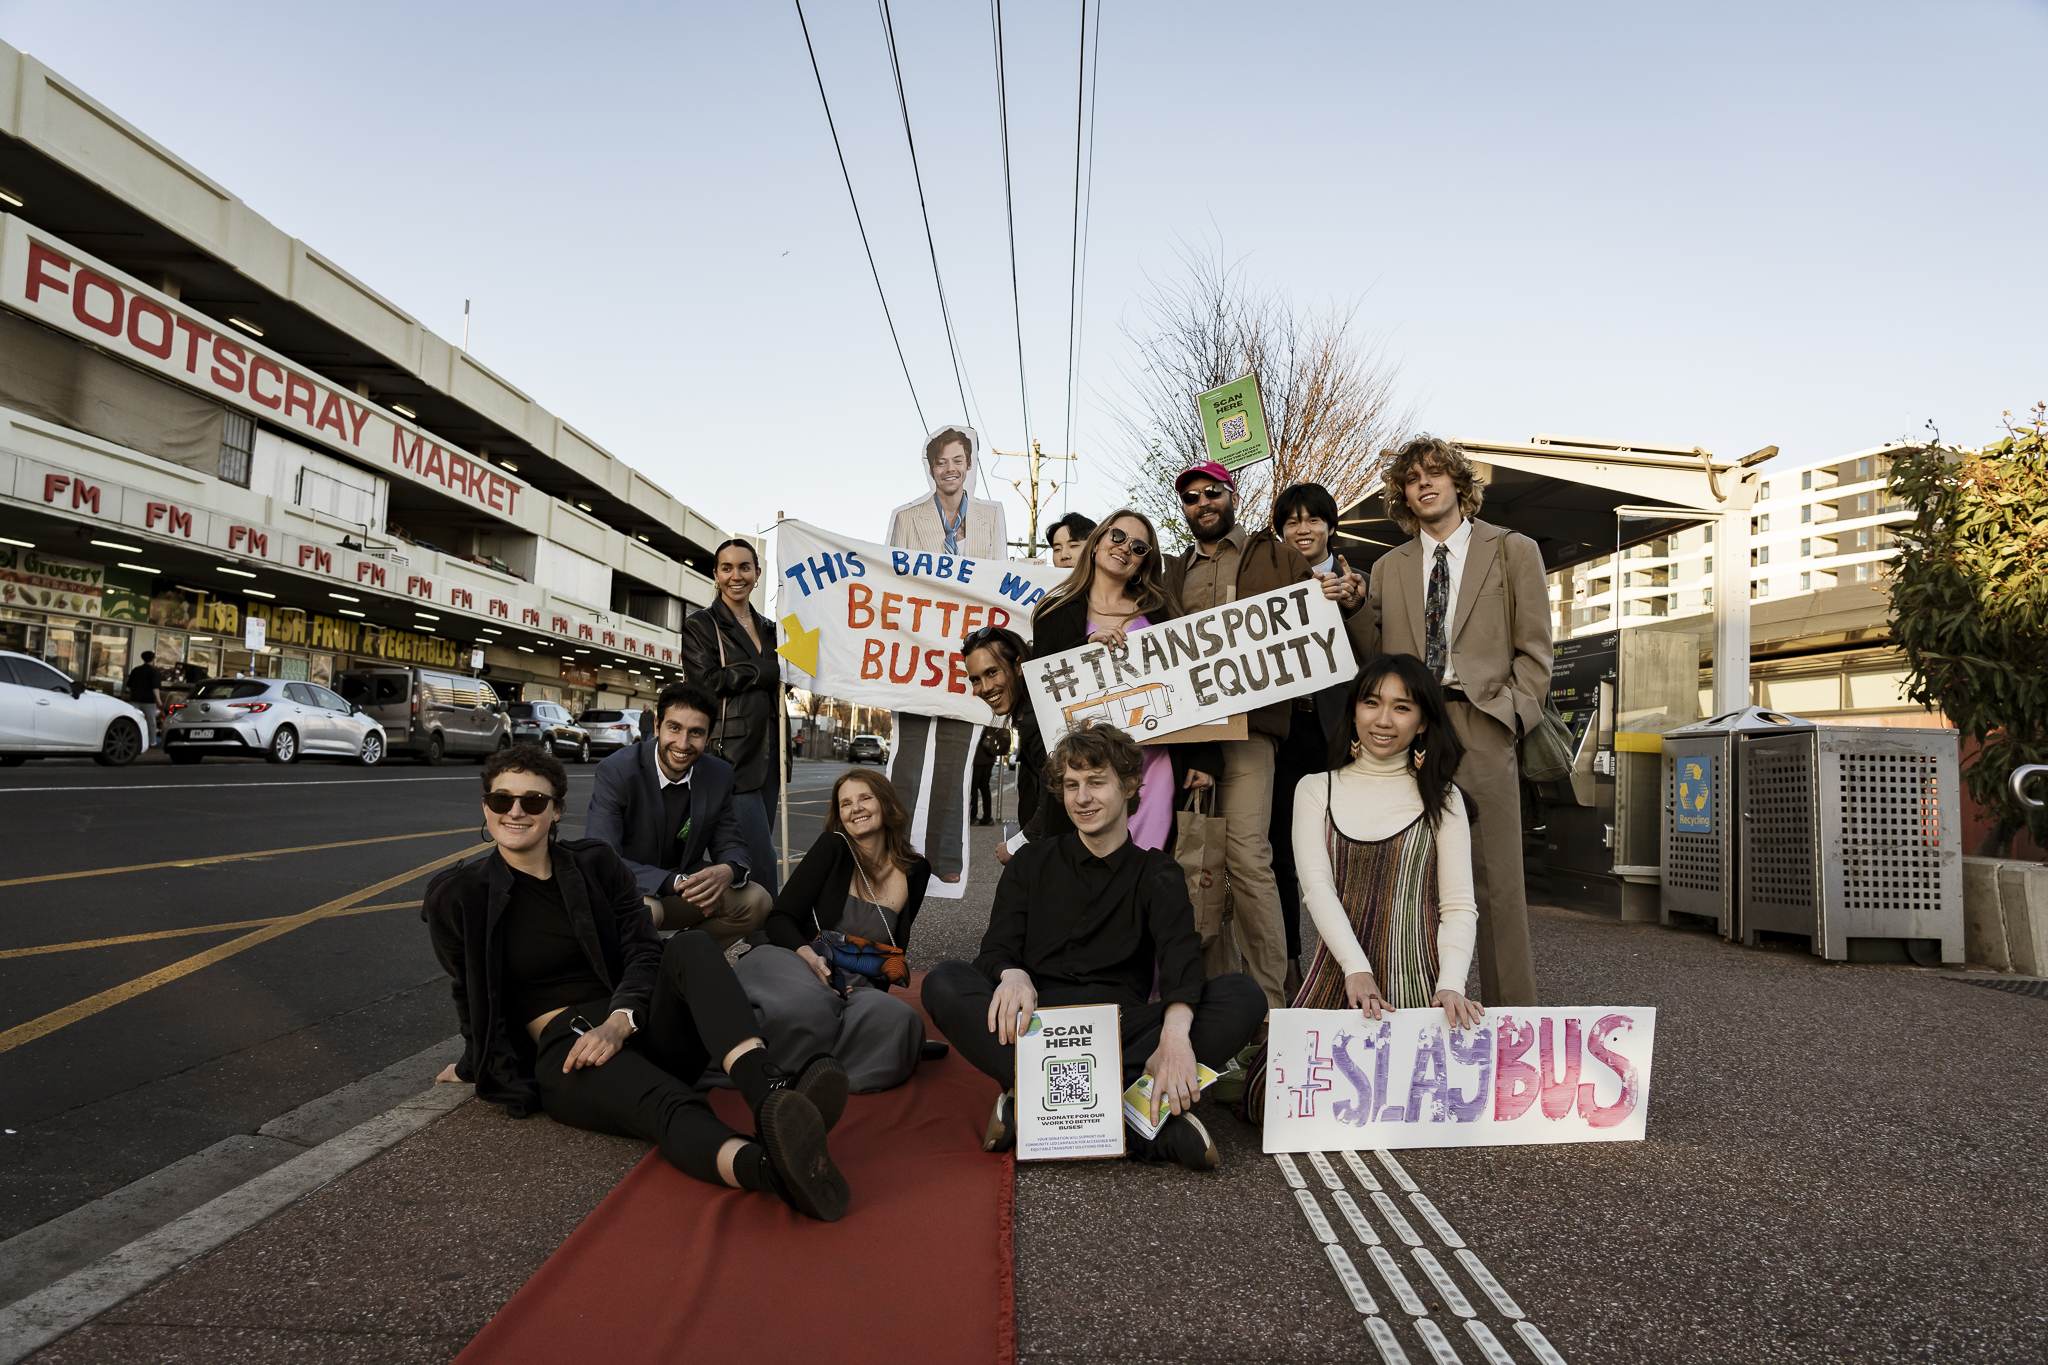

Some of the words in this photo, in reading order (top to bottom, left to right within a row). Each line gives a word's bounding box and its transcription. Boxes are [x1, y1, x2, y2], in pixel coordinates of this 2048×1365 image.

[25, 241, 371, 447] FOOTSCRAY
[392, 424, 521, 516] MARKET
[1213, 393, 1243, 409] SCAN
[1216, 400, 1243, 415] HERE
[24, 551, 102, 588] Grocery
[43, 473, 100, 513] FM
[146, 502, 192, 537] FM
[229, 525, 268, 556] FM
[298, 544, 332, 572] FM
[357, 561, 385, 587] FM
[407, 575, 432, 598] FM
[451, 588, 473, 609] FM
[489, 599, 508, 619] FM
[522, 608, 540, 627] FM
[552, 616, 568, 634] FM
[578, 623, 593, 640] FM
[602, 631, 616, 647] FM
[624, 637, 636, 652] FM
[643, 643, 655, 657] FM
[661, 648, 673, 662] FM
[785, 551, 866, 597] THIS
[891, 550, 975, 584] BABE
[196, 592, 239, 633] Lisa
[312, 614, 361, 652] FRUIT
[362, 626, 374, 655] &
[378, 628, 457, 668] VEGETABLES
[847, 583, 1010, 640] BETTER
[860, 638, 976, 697] BUSE
[1040, 587, 1310, 702] #TRANSPORT
[1188, 627, 1336, 707] EQUITY
[1679, 814, 1710, 828] Recycling
[1042, 1024, 1093, 1037] SCAN
[1045, 1036, 1092, 1048] HERE
